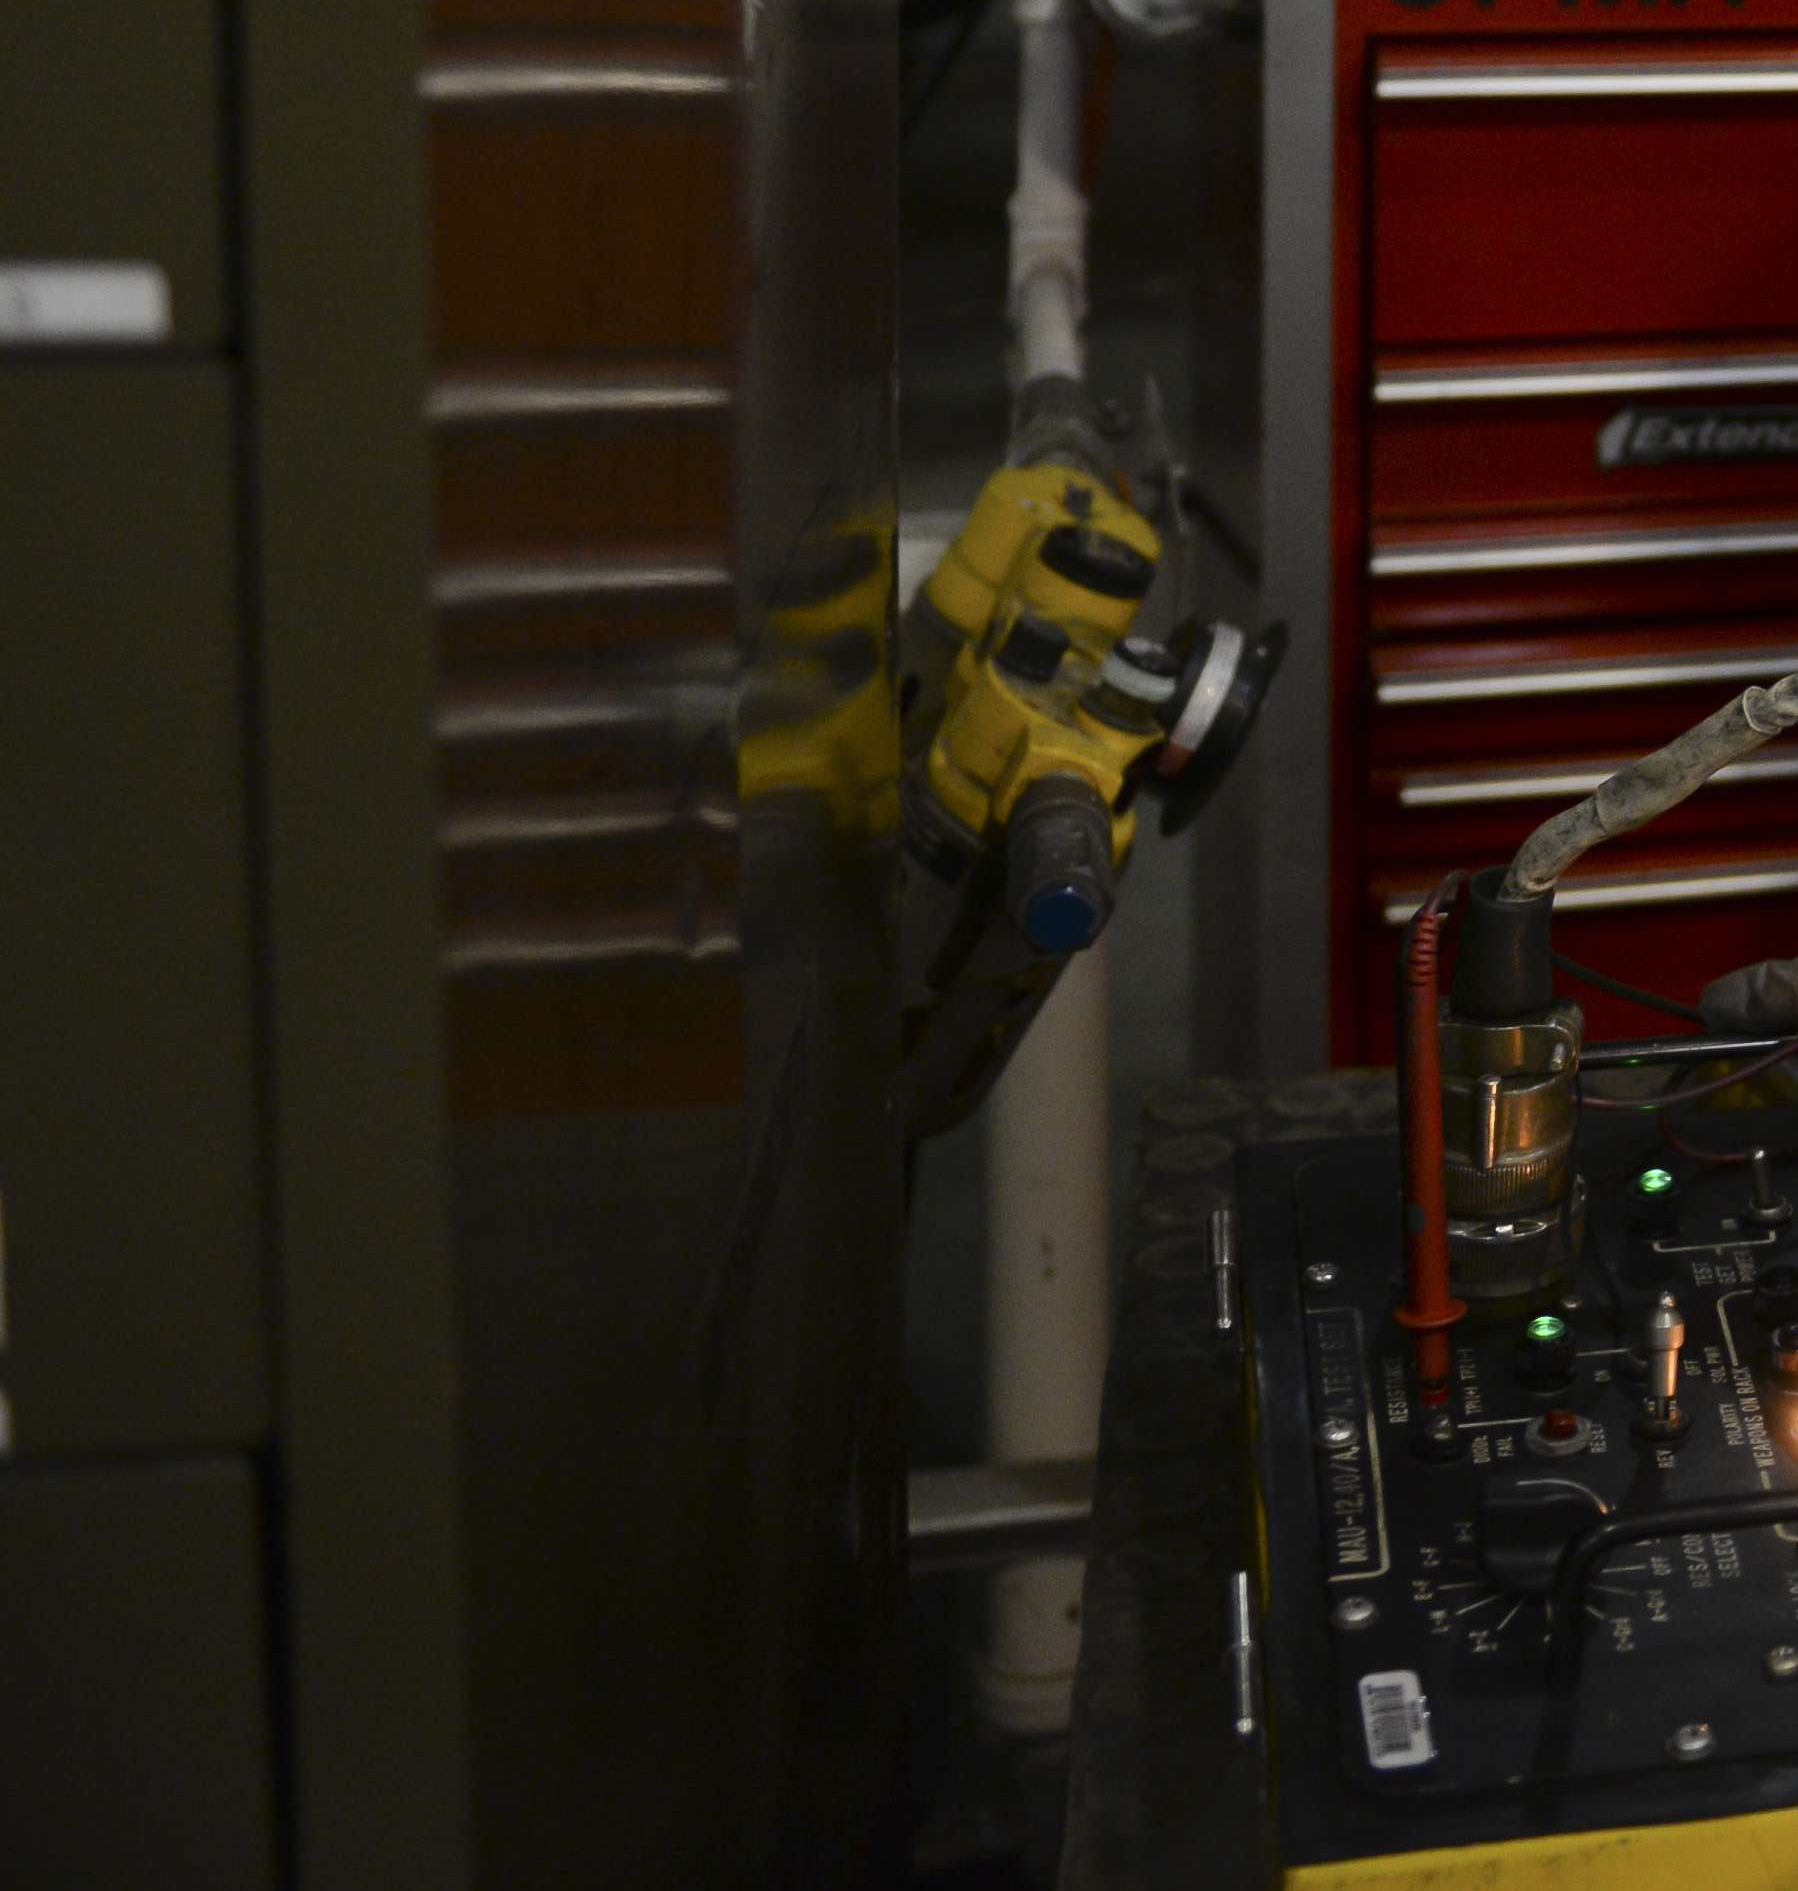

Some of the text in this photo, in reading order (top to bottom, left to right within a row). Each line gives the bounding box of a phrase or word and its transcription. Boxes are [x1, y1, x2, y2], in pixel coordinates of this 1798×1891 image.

[1691, 1261, 1714, 1287] TEST
[1322, 1357, 1352, 1396] TEST
[1683, 1359, 1702, 1376] OFF
[1383, 1355, 1409, 1423] RESISTANCE
[1719, 1403, 1744, 1446] POLARITY
[1731, 1366, 1776, 1468] WEAPONS ON RACK
[1496, 1436, 1514, 1458] FAIL
[1656, 1449, 1675, 1468] REV
[1650, 1556, 1672, 1576] OFF
[1711, 1532, 1741, 1579] SELECT
